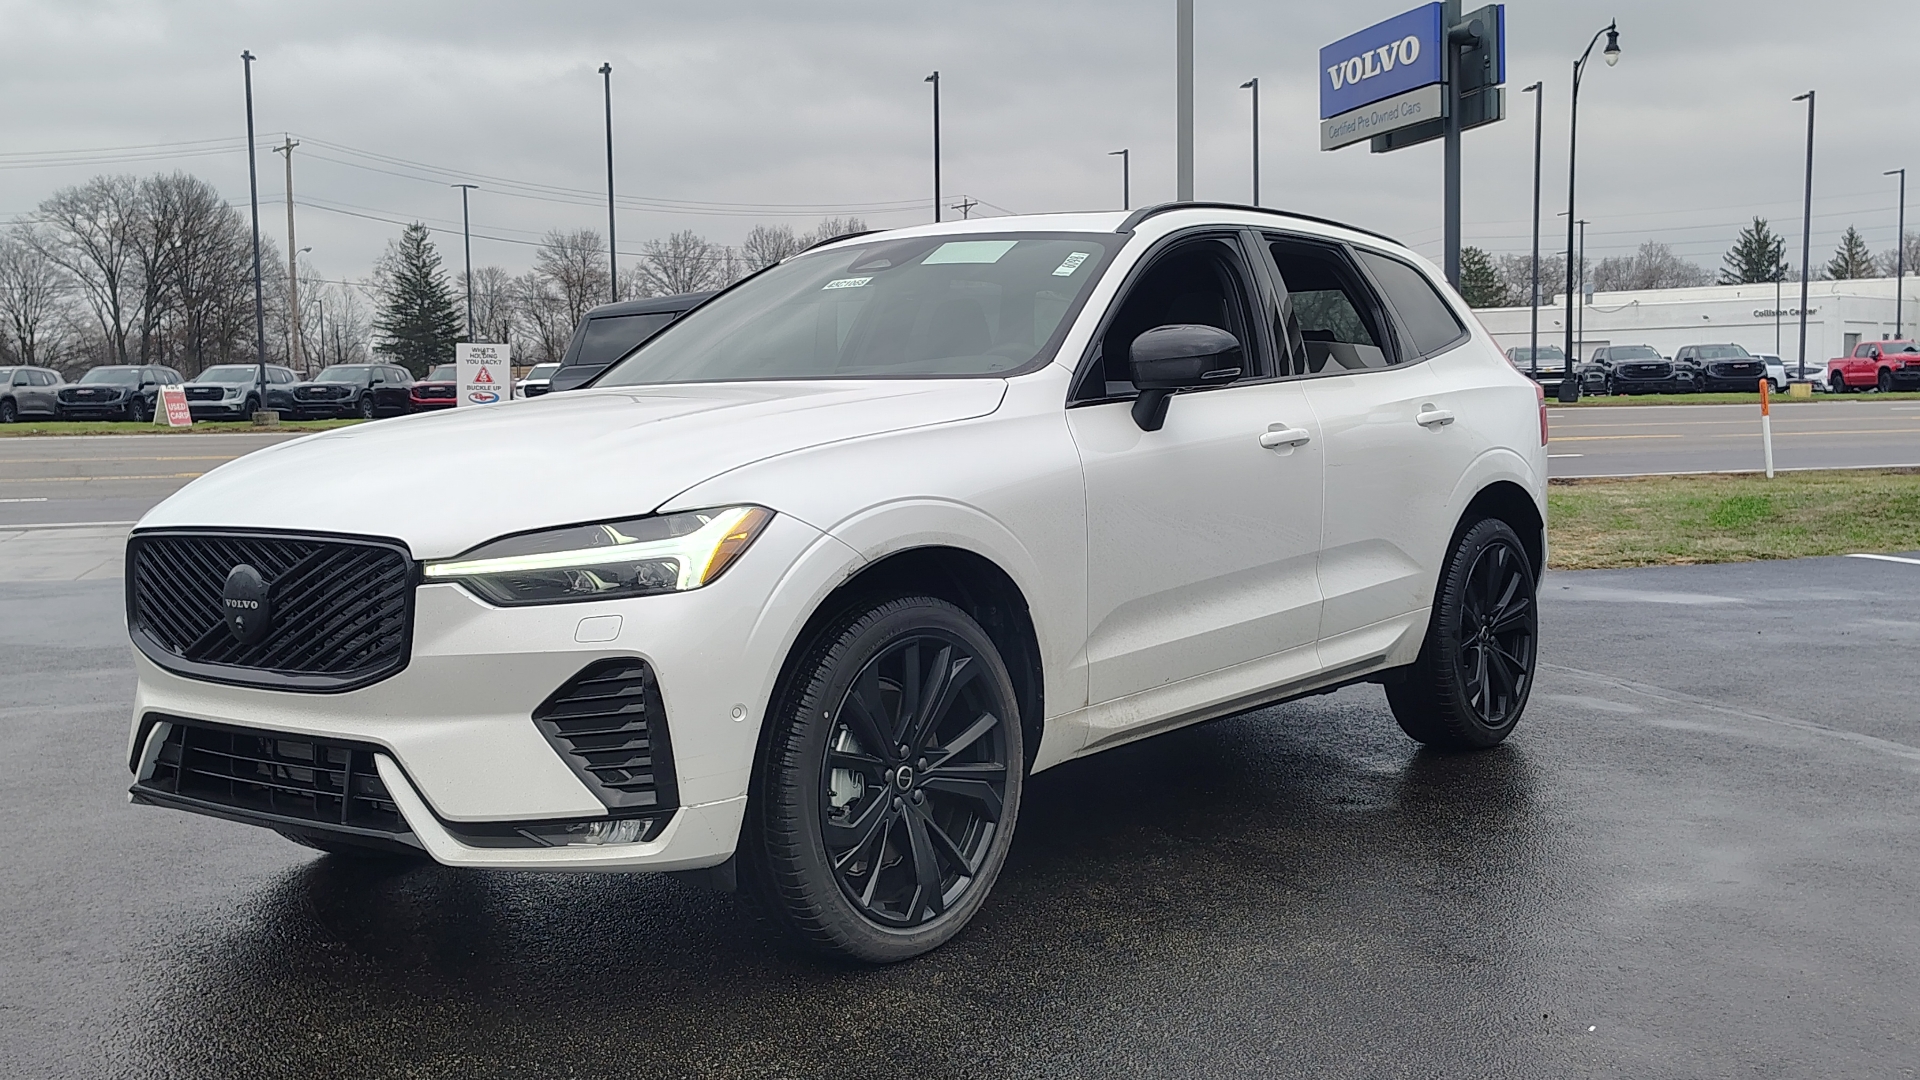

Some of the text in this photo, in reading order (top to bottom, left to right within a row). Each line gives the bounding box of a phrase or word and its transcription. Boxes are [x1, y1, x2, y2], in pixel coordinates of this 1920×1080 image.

[1327, 35, 1420, 90] VOLVO
[1329, 102, 1421, 139] Certified Pre Owned Cars
[1789, 308, 1817, 316] Ceer
[168, 402, 186, 411] USED
[170, 411, 190, 420] CARS
[225, 598, 259, 610] VOLVO
